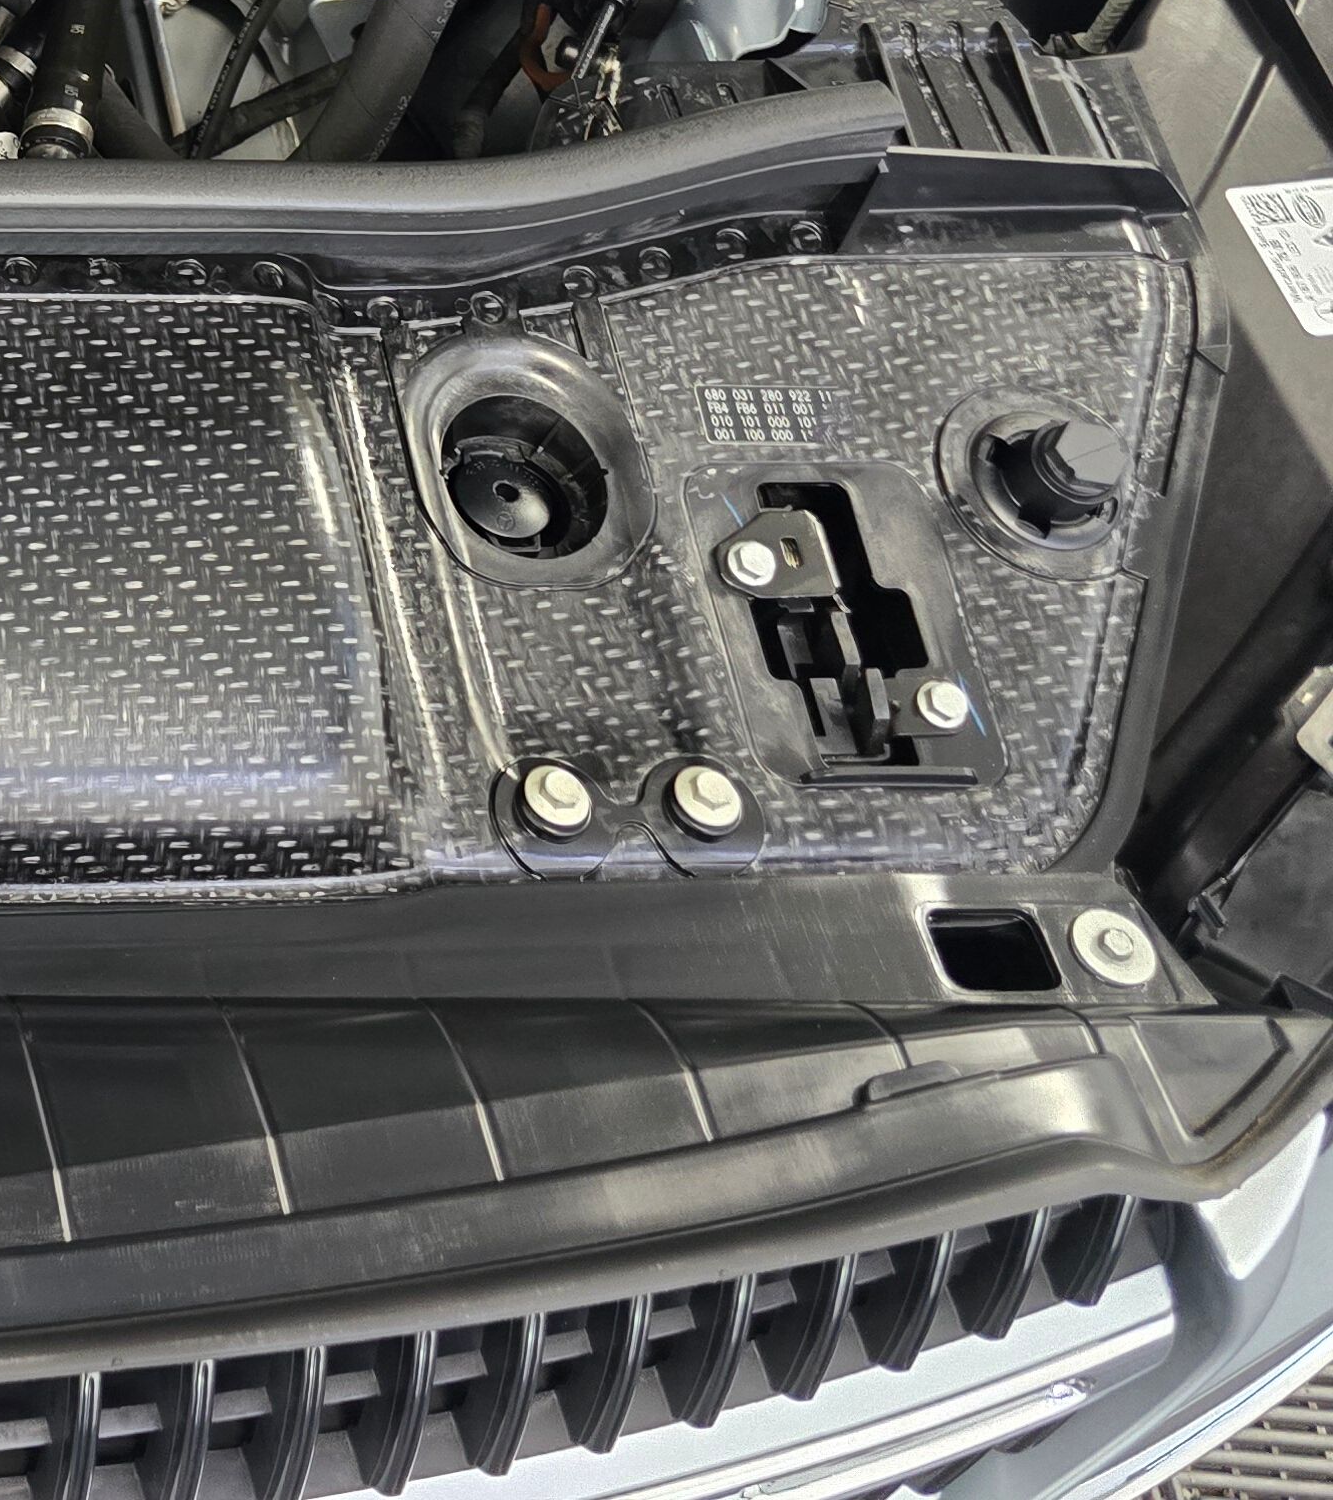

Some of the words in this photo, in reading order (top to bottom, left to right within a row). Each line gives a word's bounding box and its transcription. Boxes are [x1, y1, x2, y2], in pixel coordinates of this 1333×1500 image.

[704, 388, 727, 401] 680
[732, 388, 754, 401] 031
[760, 389, 783, 402] 280
[788, 389, 812, 402] 922
[707, 401, 729, 414] FB4
[735, 401, 758, 414] FB6
[764, 402, 786, 415] 011
[792, 403, 815, 416] 001
[711, 415, 734, 428] 010
[740, 415, 762, 428] 101
[767, 416, 791, 428] 000
[714, 428, 736, 441] 001
[744, 429, 766, 441] 100
[771, 429, 794, 442] 000
